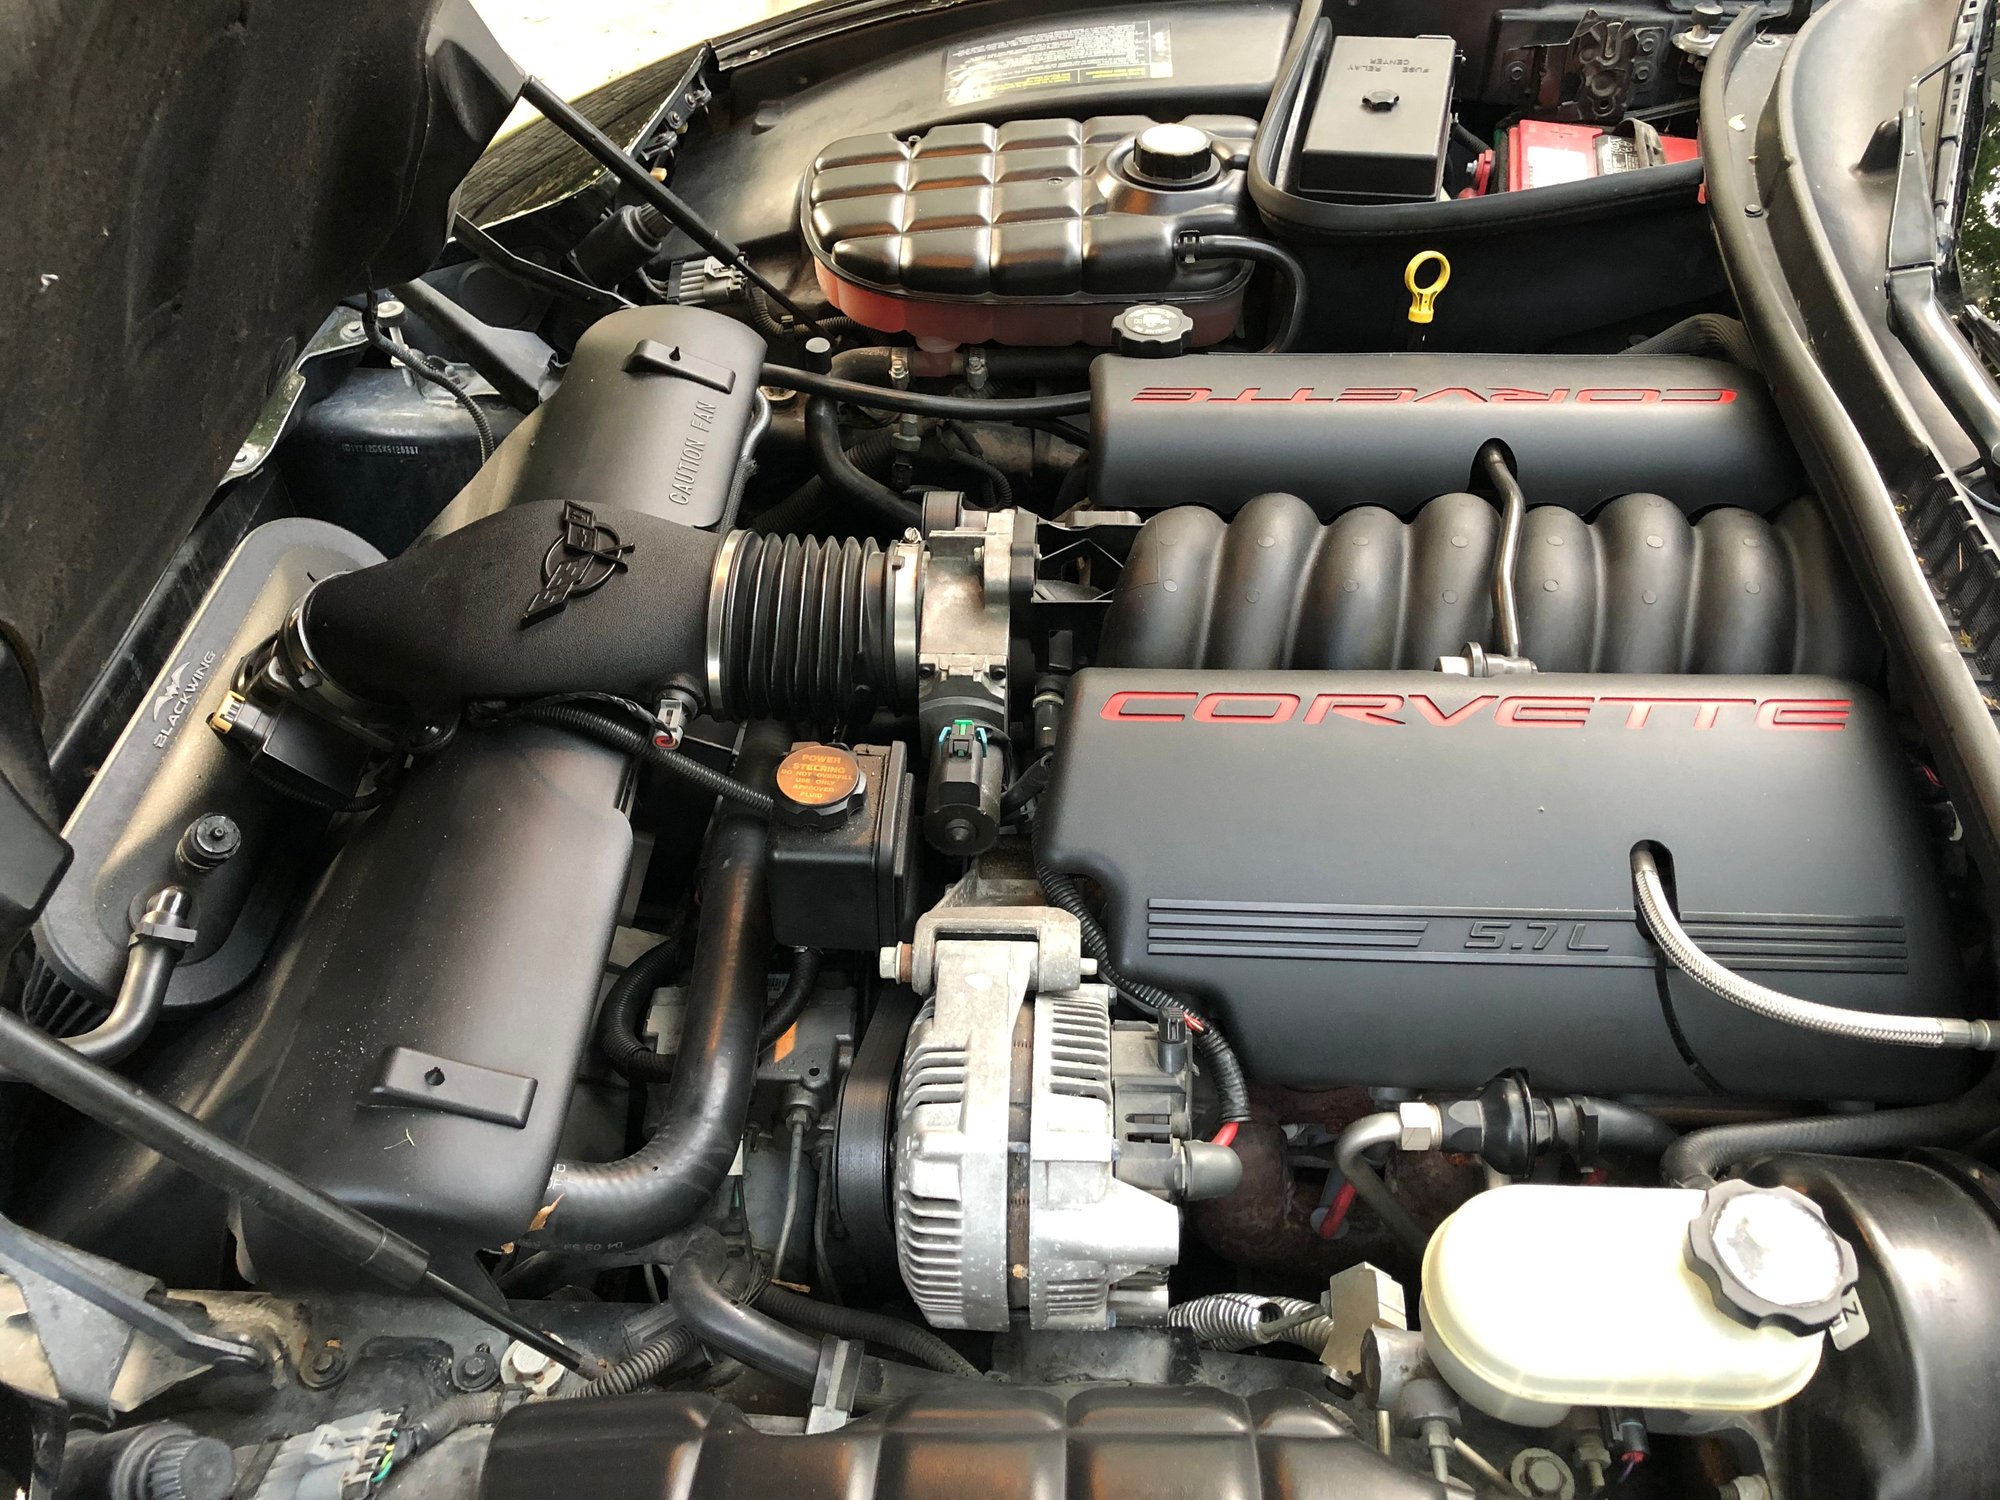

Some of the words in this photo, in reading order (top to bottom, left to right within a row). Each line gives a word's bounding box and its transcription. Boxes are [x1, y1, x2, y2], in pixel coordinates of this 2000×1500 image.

[1369, 58, 1410, 66] CENTER
[1347, 64, 1382, 73] RELAY
[1401, 66, 1429, 74] FUSE
[1131, 387, 1738, 404] CORVETTE
[668, 437, 706, 506] CAUTION
[690, 400, 717, 433] FAN
[153, 650, 216, 748] BLACKWING
[1099, 691, 1853, 732] CORVETTE
[801, 754, 842, 764] POWER
[792, 762, 846, 774] STEERING
[800, 791, 823, 799] FLUID
[1464, 921, 1610, 951] 5.7L
